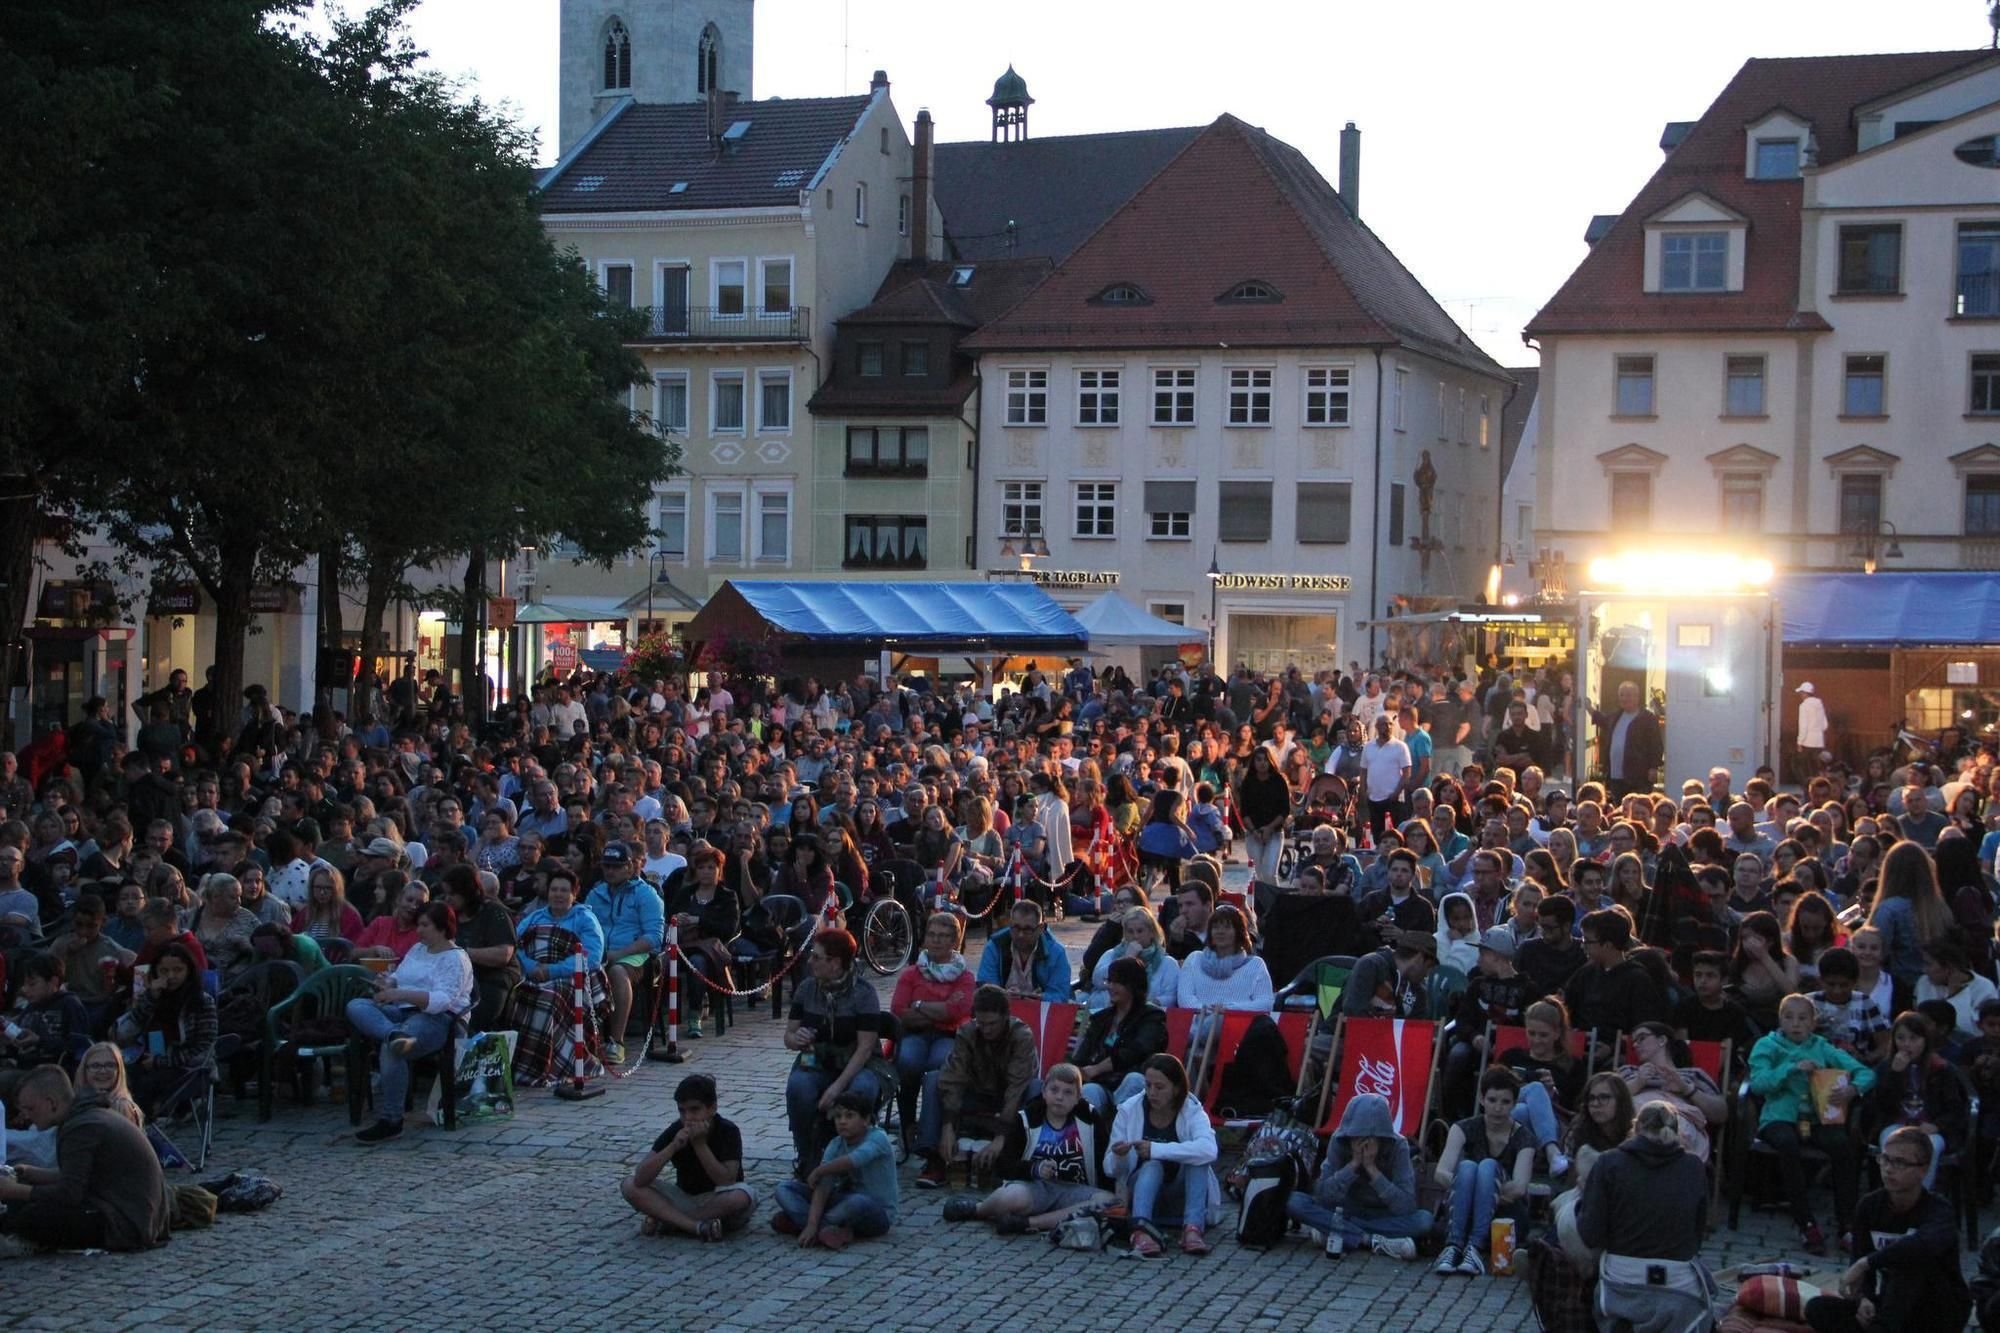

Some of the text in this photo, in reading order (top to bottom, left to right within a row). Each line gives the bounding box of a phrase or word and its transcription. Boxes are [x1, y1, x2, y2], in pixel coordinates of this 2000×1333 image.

[1053, 571, 1119, 584] TAGBLATT
[1215, 572, 1350, 589] SÜDWEST PRESSE
